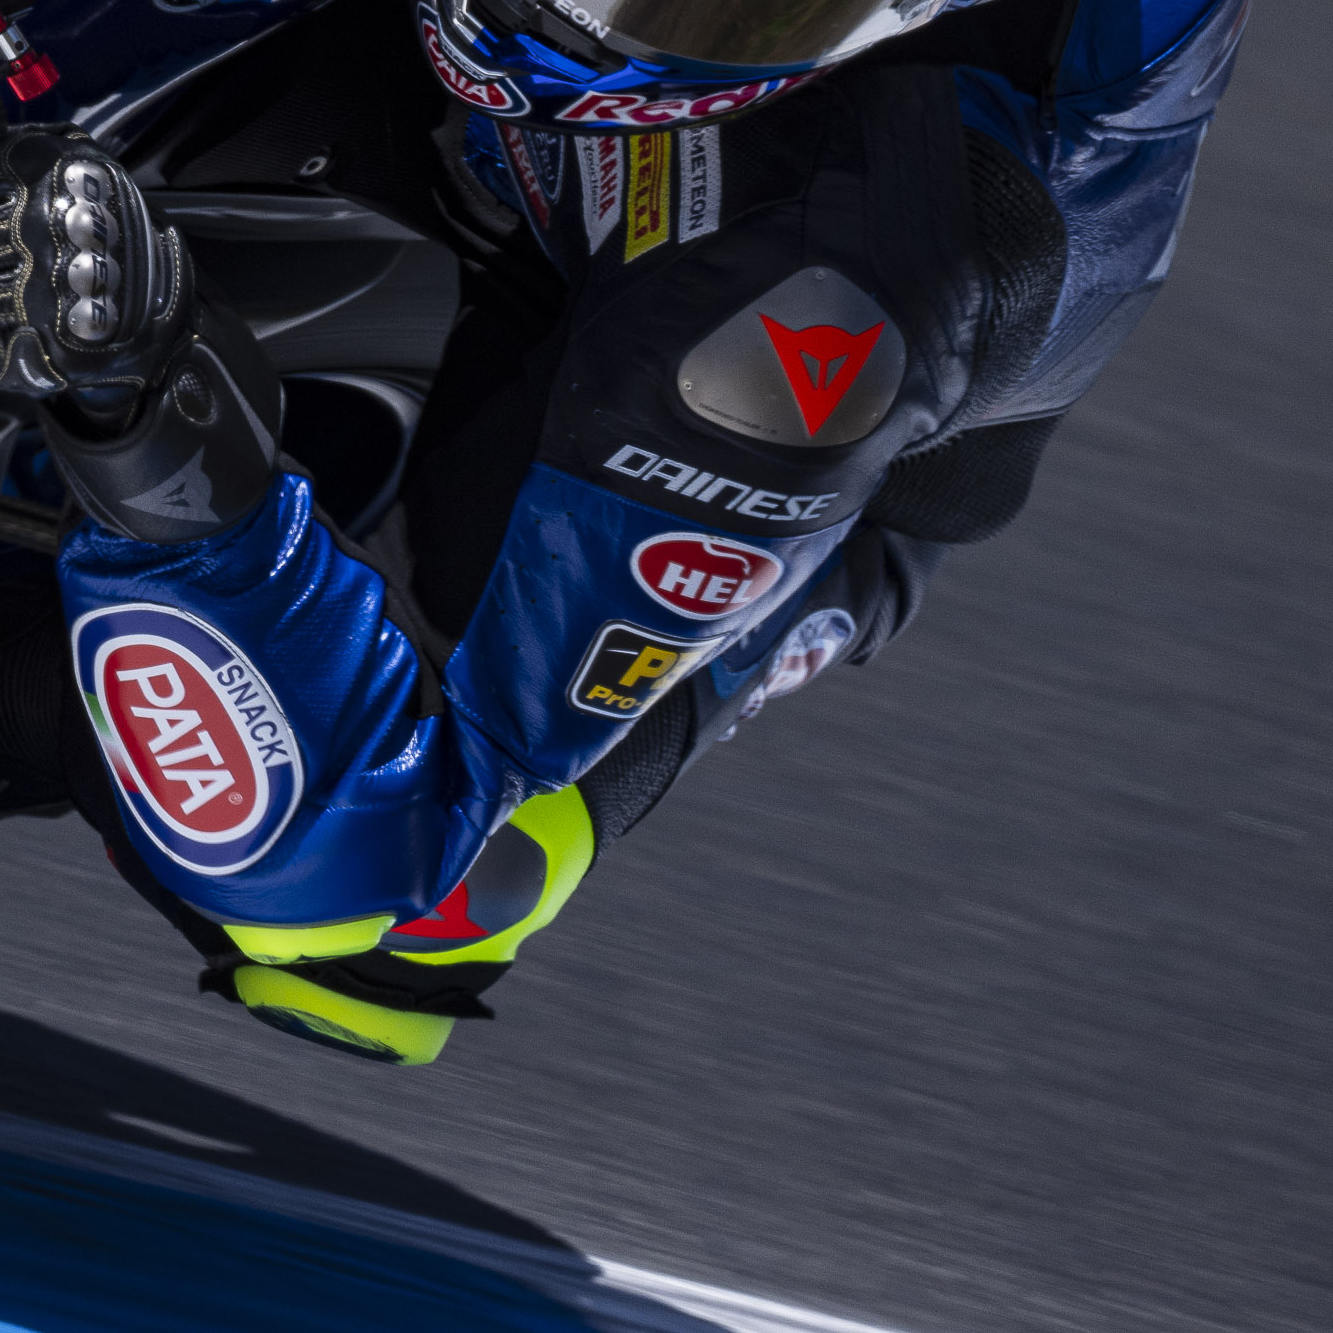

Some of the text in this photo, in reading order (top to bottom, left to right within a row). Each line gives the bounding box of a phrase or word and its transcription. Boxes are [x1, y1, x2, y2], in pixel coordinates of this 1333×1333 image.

[83, 173, 115, 331] DAINESE
[602, 443, 842, 523] DAINESE
[657, 561, 754, 607] HEL
[116, 662, 237, 817] PATA
[217, 663, 289, 766] SNACK
